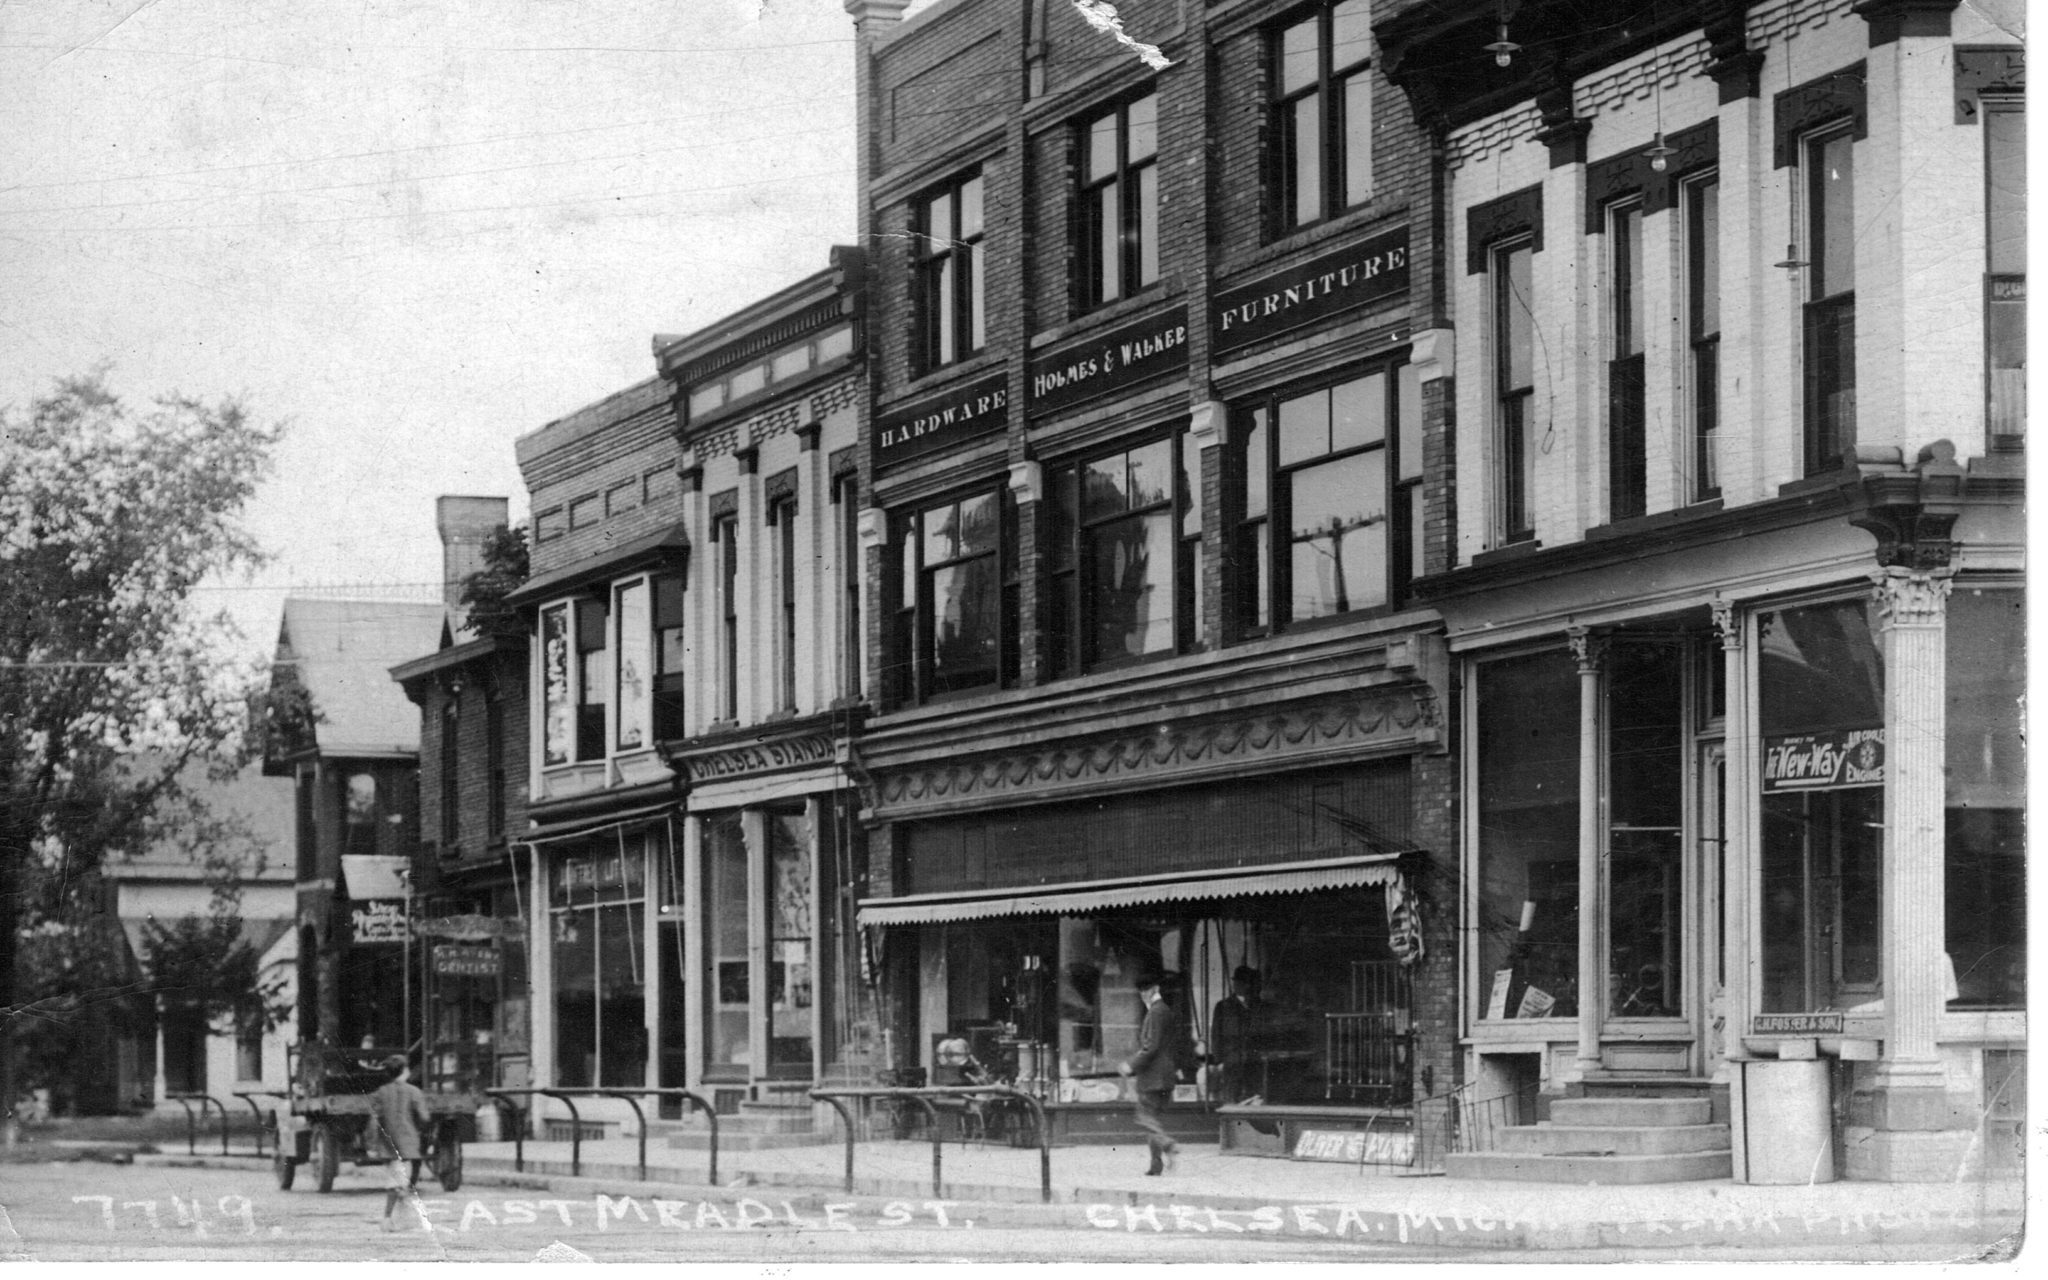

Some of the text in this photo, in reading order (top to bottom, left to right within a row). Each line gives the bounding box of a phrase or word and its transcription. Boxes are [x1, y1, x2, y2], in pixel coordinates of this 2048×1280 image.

[1221, 246, 1406, 333] FURNITURE
[1034, 325, 1187, 399] HOLMES & WALKER
[880, 389, 1007, 449] HARDWARE
[694, 735, 836, 778] CHELSEA STANDA
[1862, 729, 1885, 745] COOLE
[1846, 762, 1885, 782] ENGINE
[438, 961, 498, 974] DENTIST
